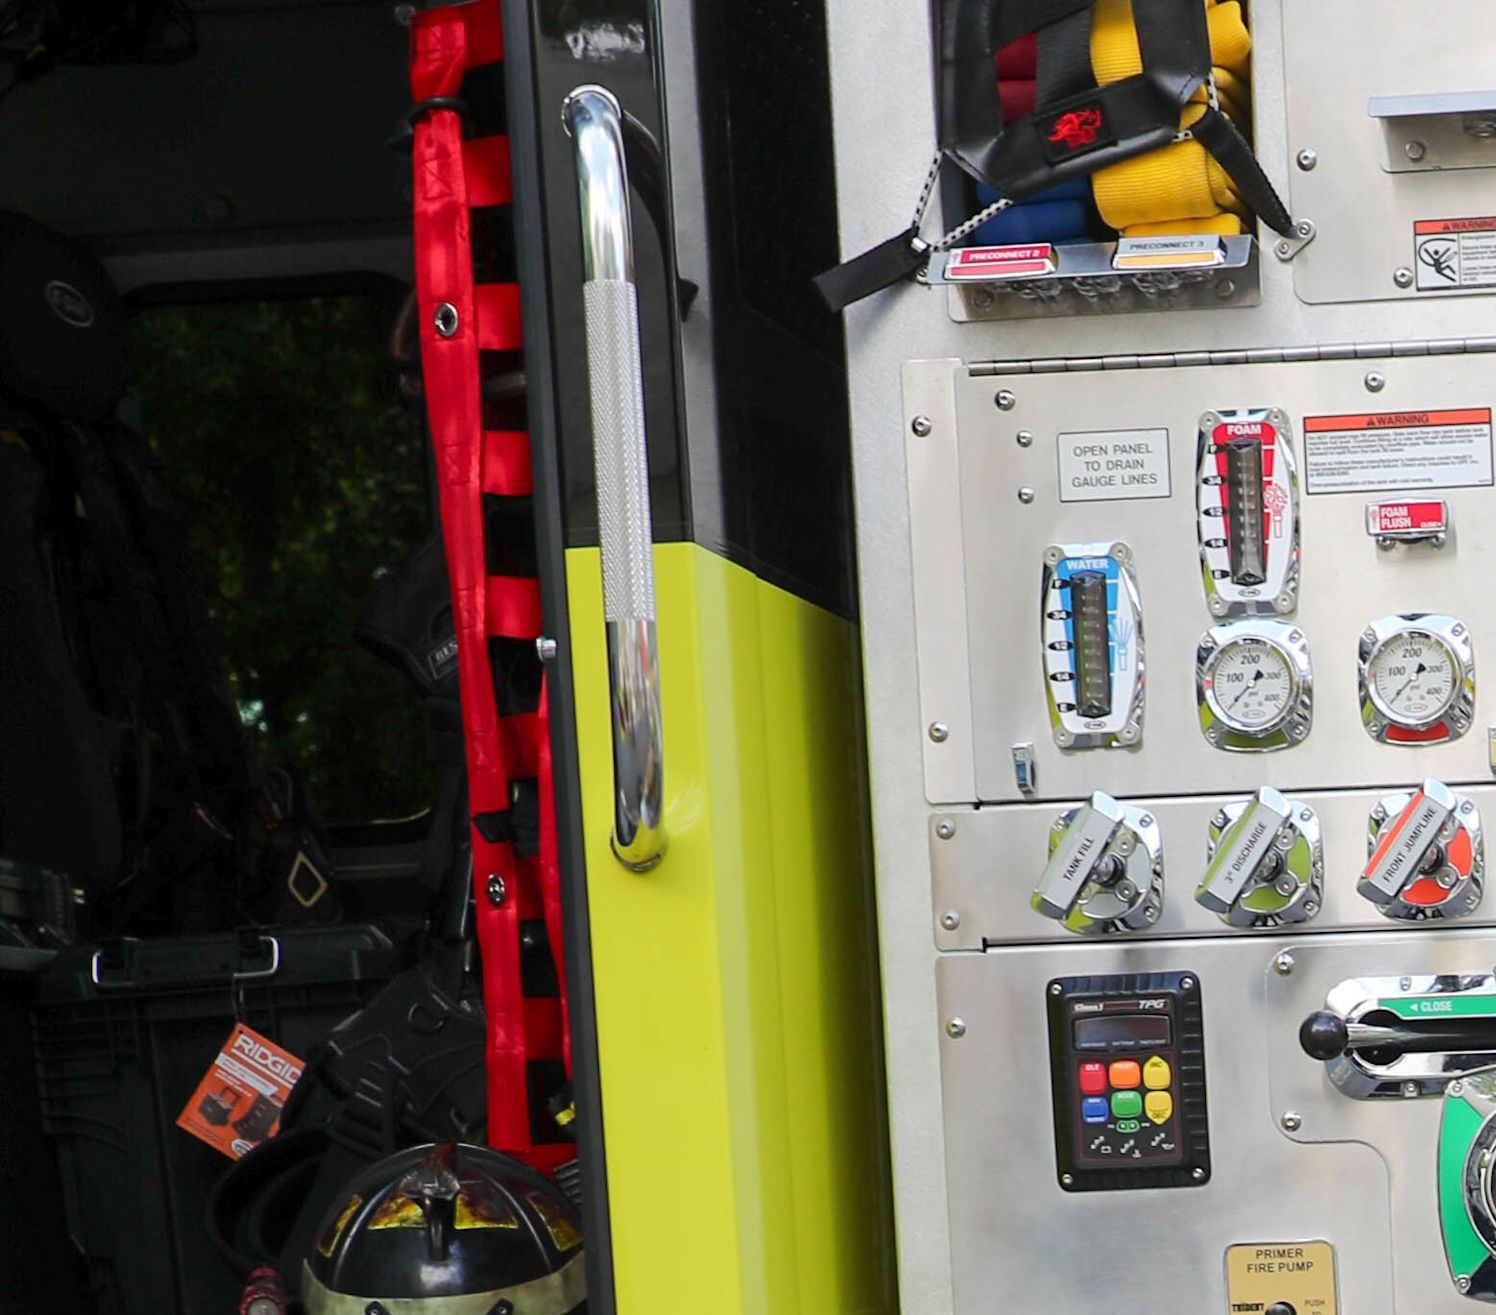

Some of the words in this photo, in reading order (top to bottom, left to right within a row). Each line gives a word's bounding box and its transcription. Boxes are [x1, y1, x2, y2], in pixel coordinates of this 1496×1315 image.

[1130, 241, 1196, 250] PRECONNECT
[969, 250, 1032, 260] PRECONNECT
[1034, 250, 1041, 258] 2
[1378, 414, 1429, 425] WARNING
[1226, 424, 1262, 436] FOAM
[1073, 444, 1111, 457] OPEN
[1114, 443, 1152, 455] PANEL
[1084, 461, 1101, 472] TO
[1106, 458, 1145, 470] DRAIN
[1072, 476, 1118, 488] GAUGE
[1121, 474, 1158, 486] LINES
[1380, 506, 1408, 517] FOAM
[1381, 517, 1412, 528] FLUSH
[1066, 559, 1108, 570] WATER
[1402, 648, 1422, 658] 200
[1240, 655, 1260, 664] 200
[1388, 666, 1406, 676] 100
[1226, 673, 1244, 682] 100
[1234, 822, 1268, 872] DISCHARGE
[1383, 850, 1406, 883] FRONT
[1406, 806, 1437, 852] JUMPLINE
[1062, 858, 1085, 882] TANK
[1078, 837, 1096, 858] FILL
[1138, 1000, 1166, 1009] TPG
[1420, 1000, 1452, 1012] CLOSE
[234, 1034, 302, 1084] RIDGID
[1256, 1248, 1304, 1259] PRIMER
[1247, 1262, 1276, 1273] FIRE
[1278, 1261, 1314, 1272] PUMP
